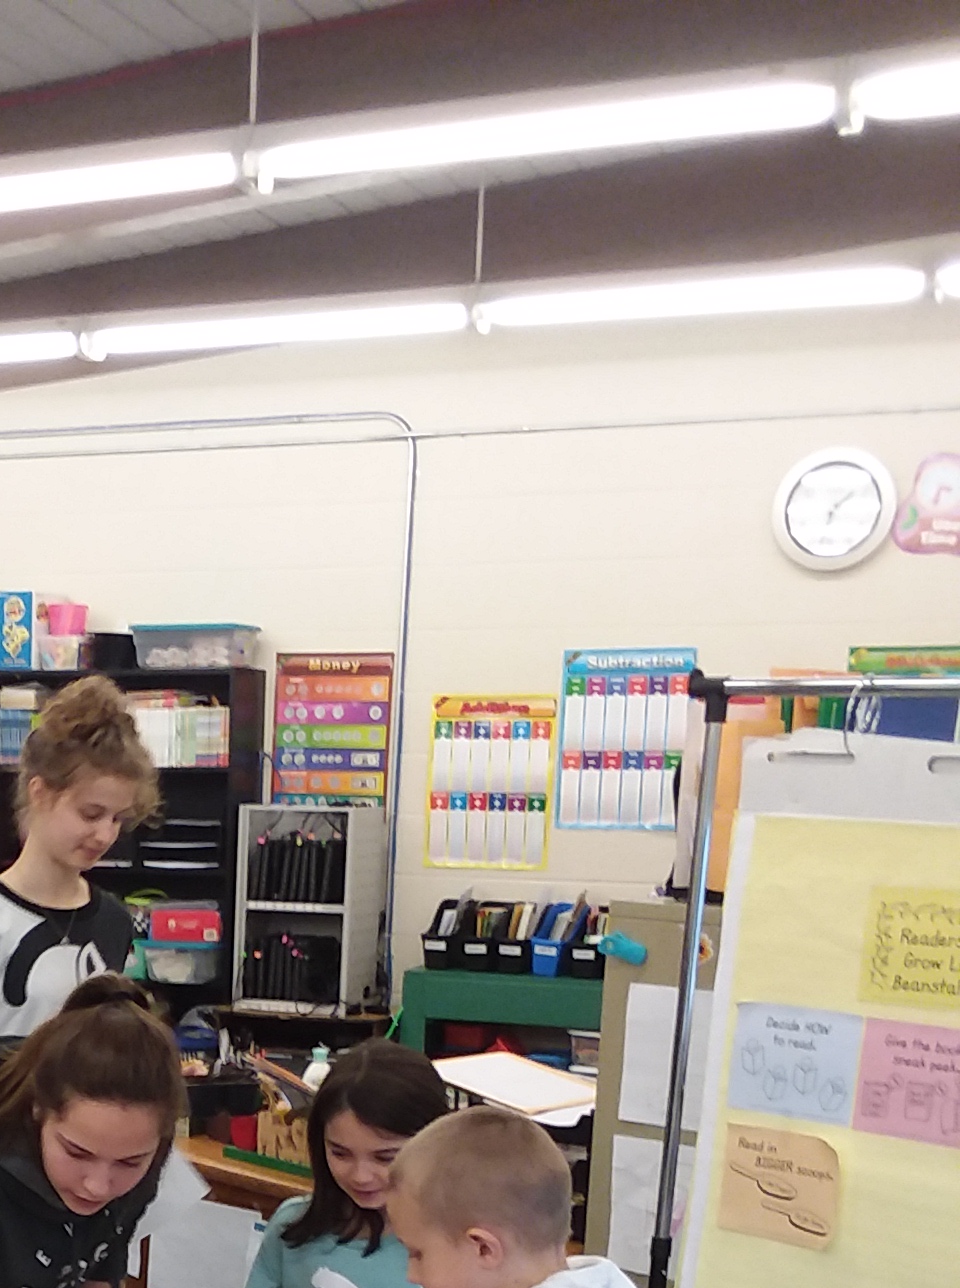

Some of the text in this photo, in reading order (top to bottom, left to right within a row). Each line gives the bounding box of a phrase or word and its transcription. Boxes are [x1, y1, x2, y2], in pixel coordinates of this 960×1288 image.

[308, 658, 361, 674] Money
[587, 654, 685, 670] Subtraction
[460, 701, 531, 717] Addition
[904, 952, 960, 972] Grow L
[765, 1015, 800, 1032] Decide
[773, 1034, 785, 1046] to
[884, 1033, 907, 1048] Give
[912, 1038, 930, 1051] the
[892, 1056, 925, 1068] sneak
[737, 1136, 777, 1153] Read in
[755, 1155, 793, 1172] BIGGER
